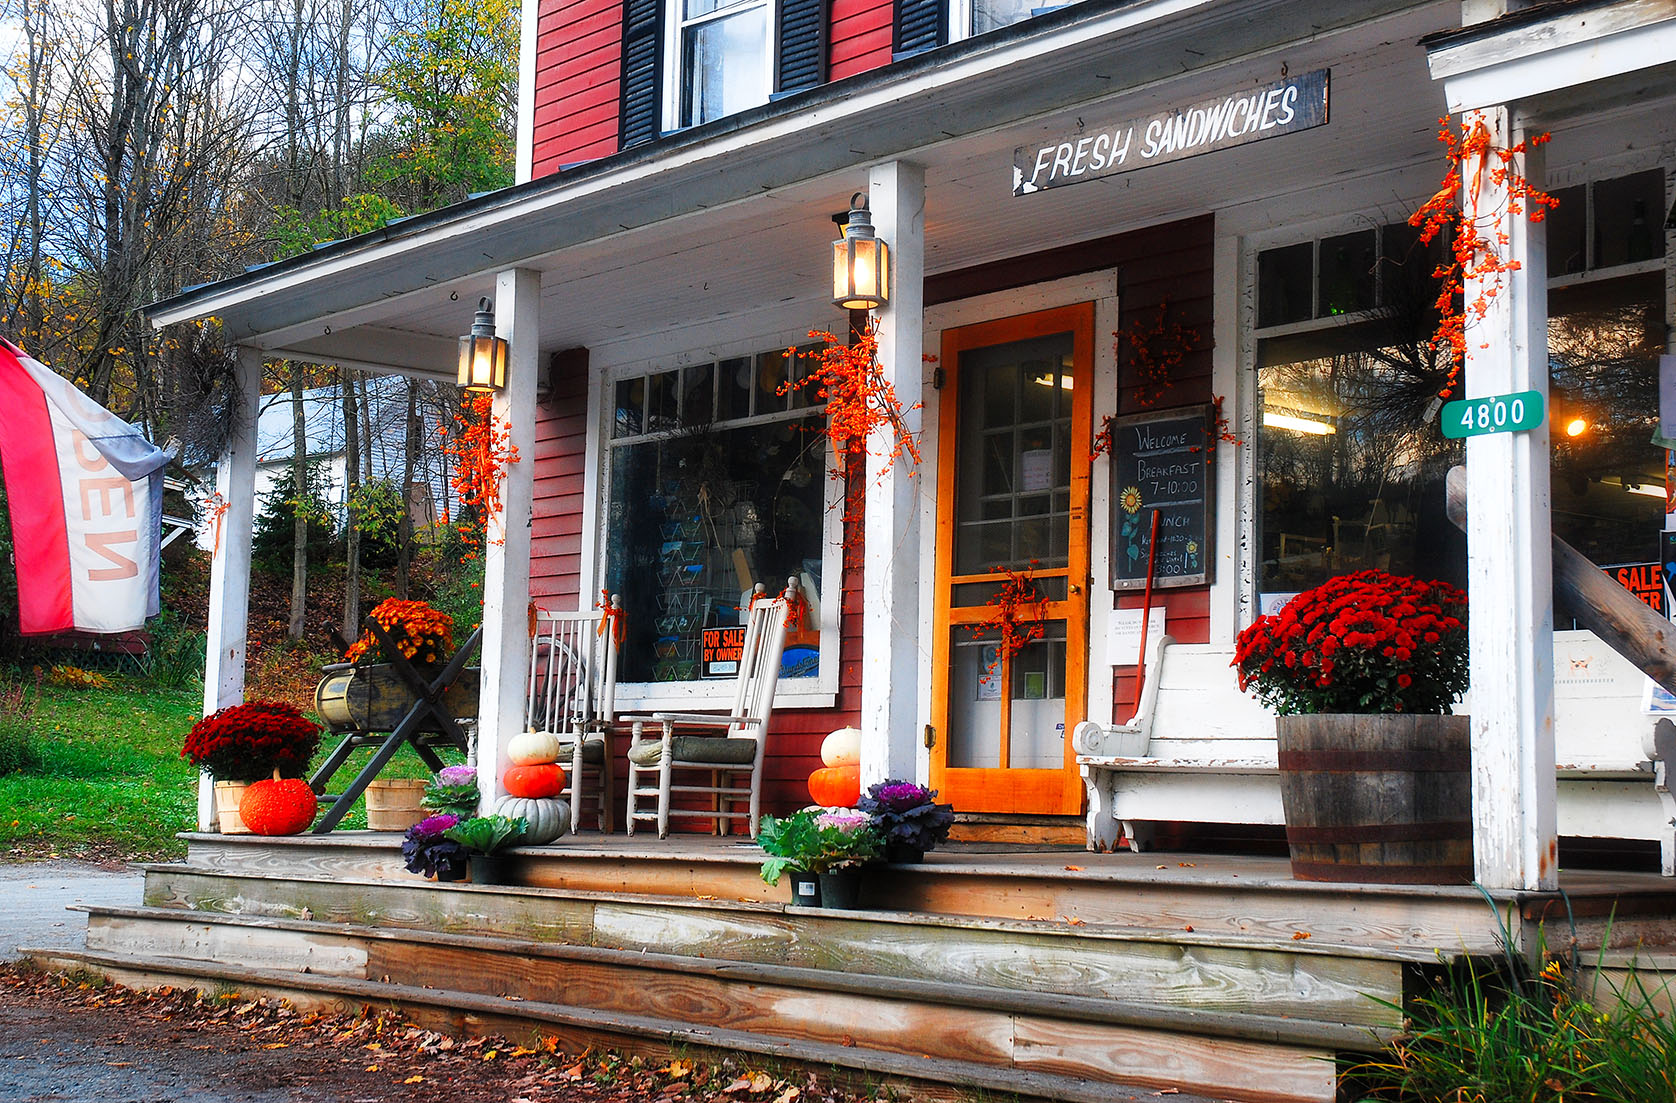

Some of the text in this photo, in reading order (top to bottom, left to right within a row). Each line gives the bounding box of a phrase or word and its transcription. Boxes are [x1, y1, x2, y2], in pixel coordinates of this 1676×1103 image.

[1031, 85, 1298, 184] FRESH SANDWICHES
[1460, 399, 1525, 430] 4800
[1138, 459, 1200, 481] BREAKFAST
[1150, 481, 1198, 495] 7-10:00
[1617, 565, 1663, 592] SALE
[703, 629, 745, 648] FOR SALE
[703, 647, 743, 661] BY OWNER
